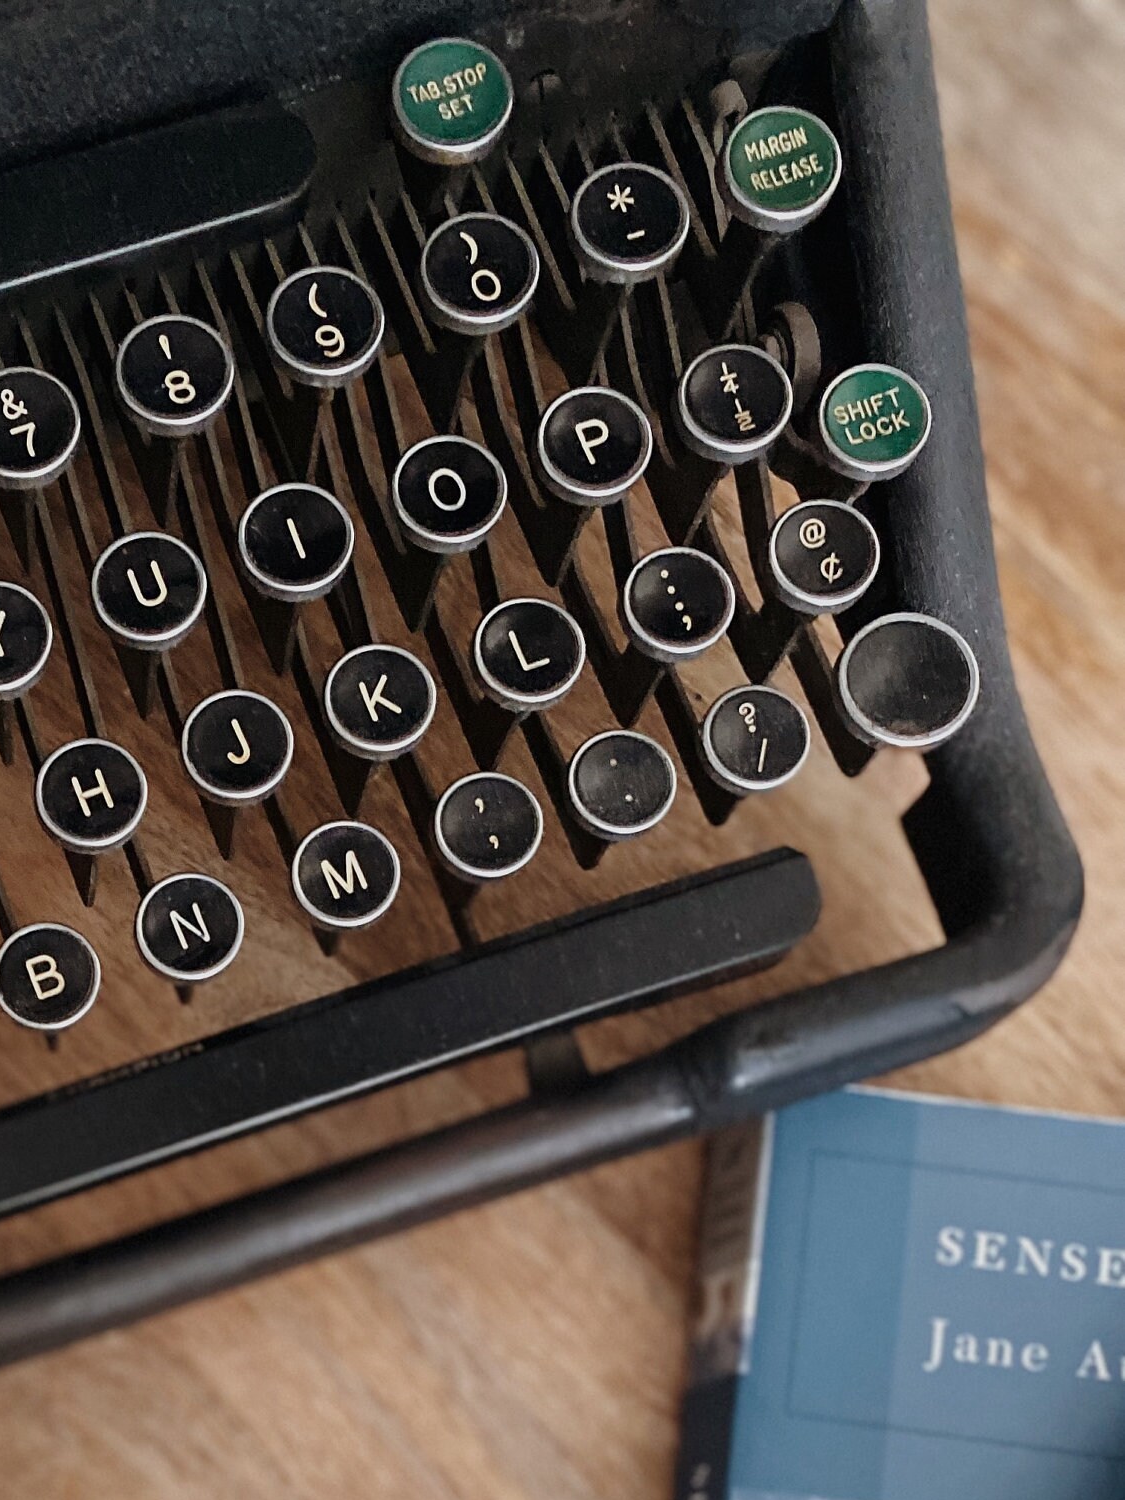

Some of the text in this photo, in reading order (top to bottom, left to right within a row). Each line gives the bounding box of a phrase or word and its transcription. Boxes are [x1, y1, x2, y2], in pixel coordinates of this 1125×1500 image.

[437, 93, 474, 121] SET
[743, 125, 808, 163] MARGIN
[750, 153, 825, 192] RELEASE
[314, 324, 345, 358] 9
[0, 388, 28, 420] &
[164, 369, 196, 405] 8
[833, 386, 901, 426] SHIFT
[9, 421, 36, 458] 7
[574, 418, 609, 465] P
[844, 408, 912, 446] LOCK
[428, 467, 467, 511] O
[799, 518, 826, 549] @
[126, 560, 168, 607] U
[508, 630, 550, 672] L
[358, 674, 402, 722] K
[737, 702, 757, 734] ?
[227, 718, 251, 765] J
[71, 768, 114, 817] H
[320, 850, 368, 900] M
[169, 902, 211, 950] N
[25, 954, 65, 1000] B
[935, 1225, 1125, 1289] SENSE
[921, 1316, 1125, 1383] Jane A
